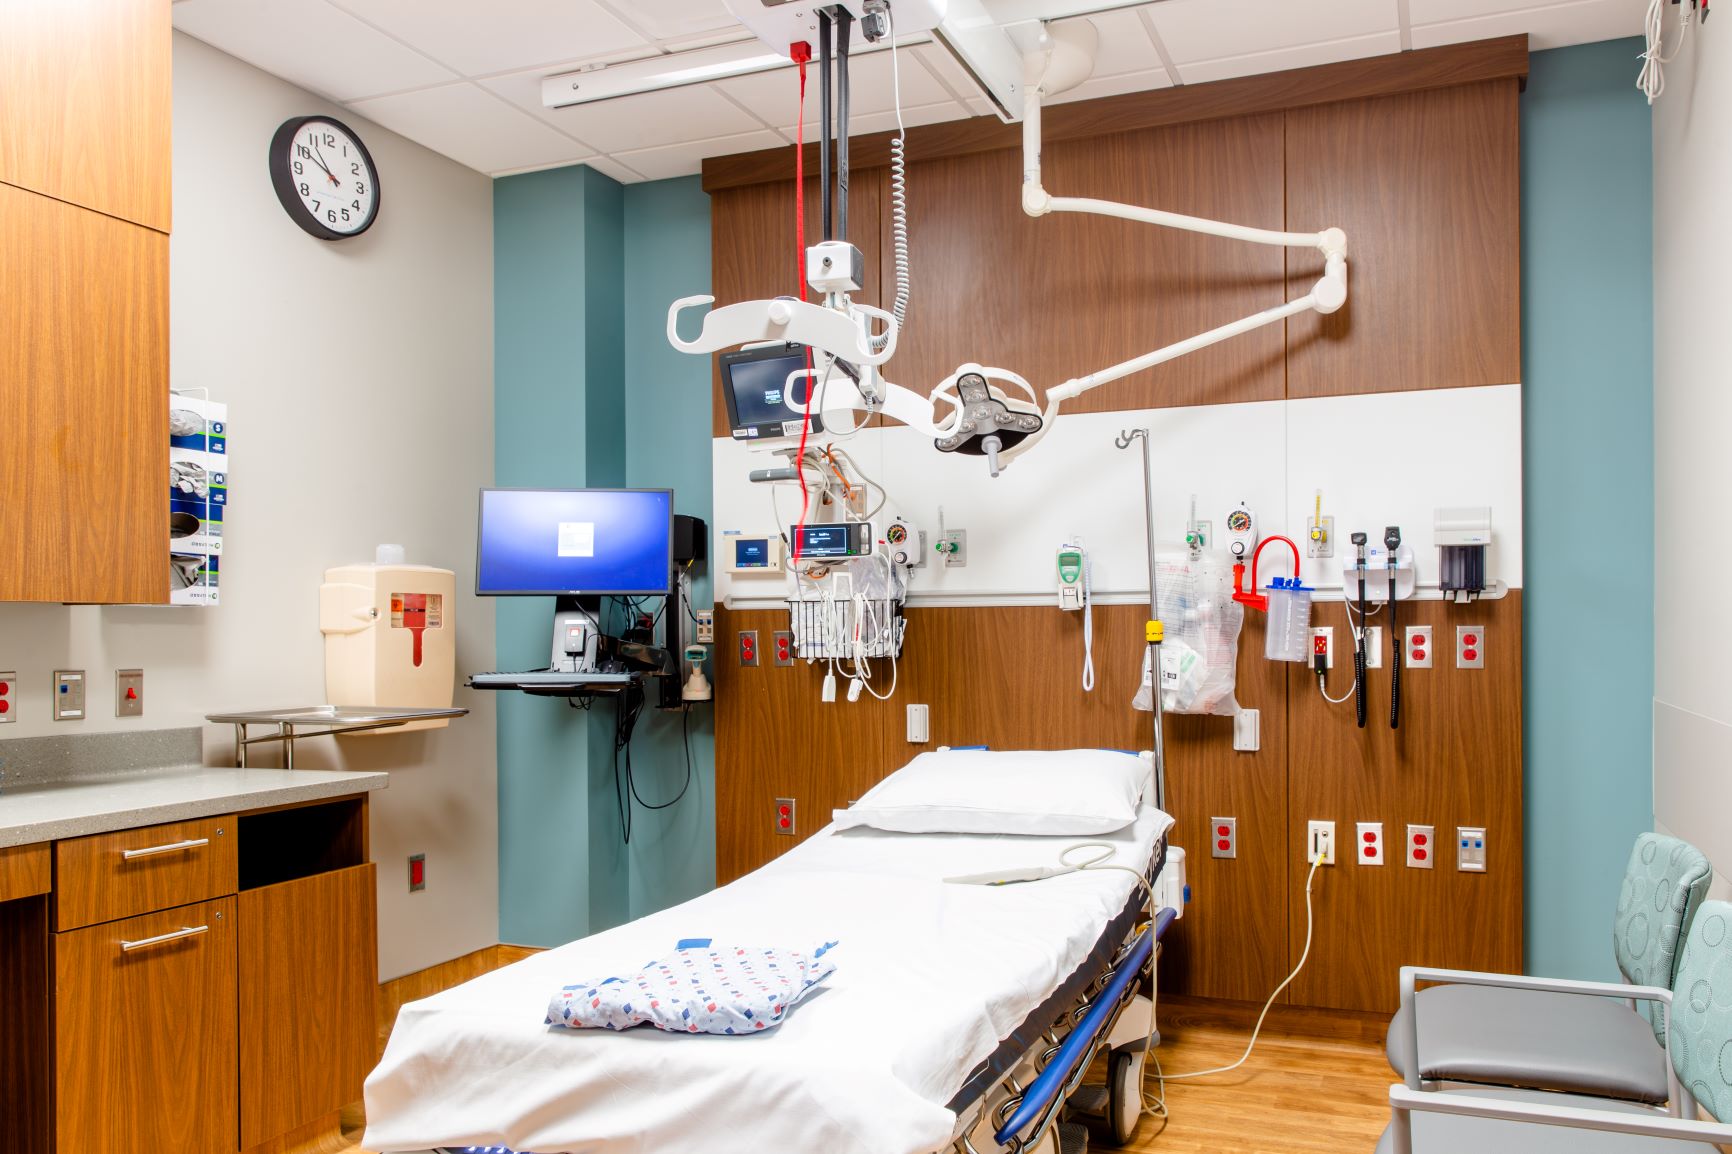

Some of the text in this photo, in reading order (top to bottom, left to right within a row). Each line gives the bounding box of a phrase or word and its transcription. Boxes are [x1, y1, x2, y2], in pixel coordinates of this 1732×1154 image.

[309, 133, 319, 148] 11
[323, 133, 335, 148] 12
[296, 144, 310, 160] 10
[343, 145, 347, 157] 1
[294, 161, 303, 175] 9
[351, 163, 359, 176] 2
[300, 183, 309, 196] 8
[356, 181, 364, 194] 3
[312, 199, 320, 212] 7
[351, 200, 360, 212] 4
[328, 210, 336, 223] 6
[341, 208, 350, 221] 5
[215, 422, 221, 432] S
[215, 475, 223, 483] M
